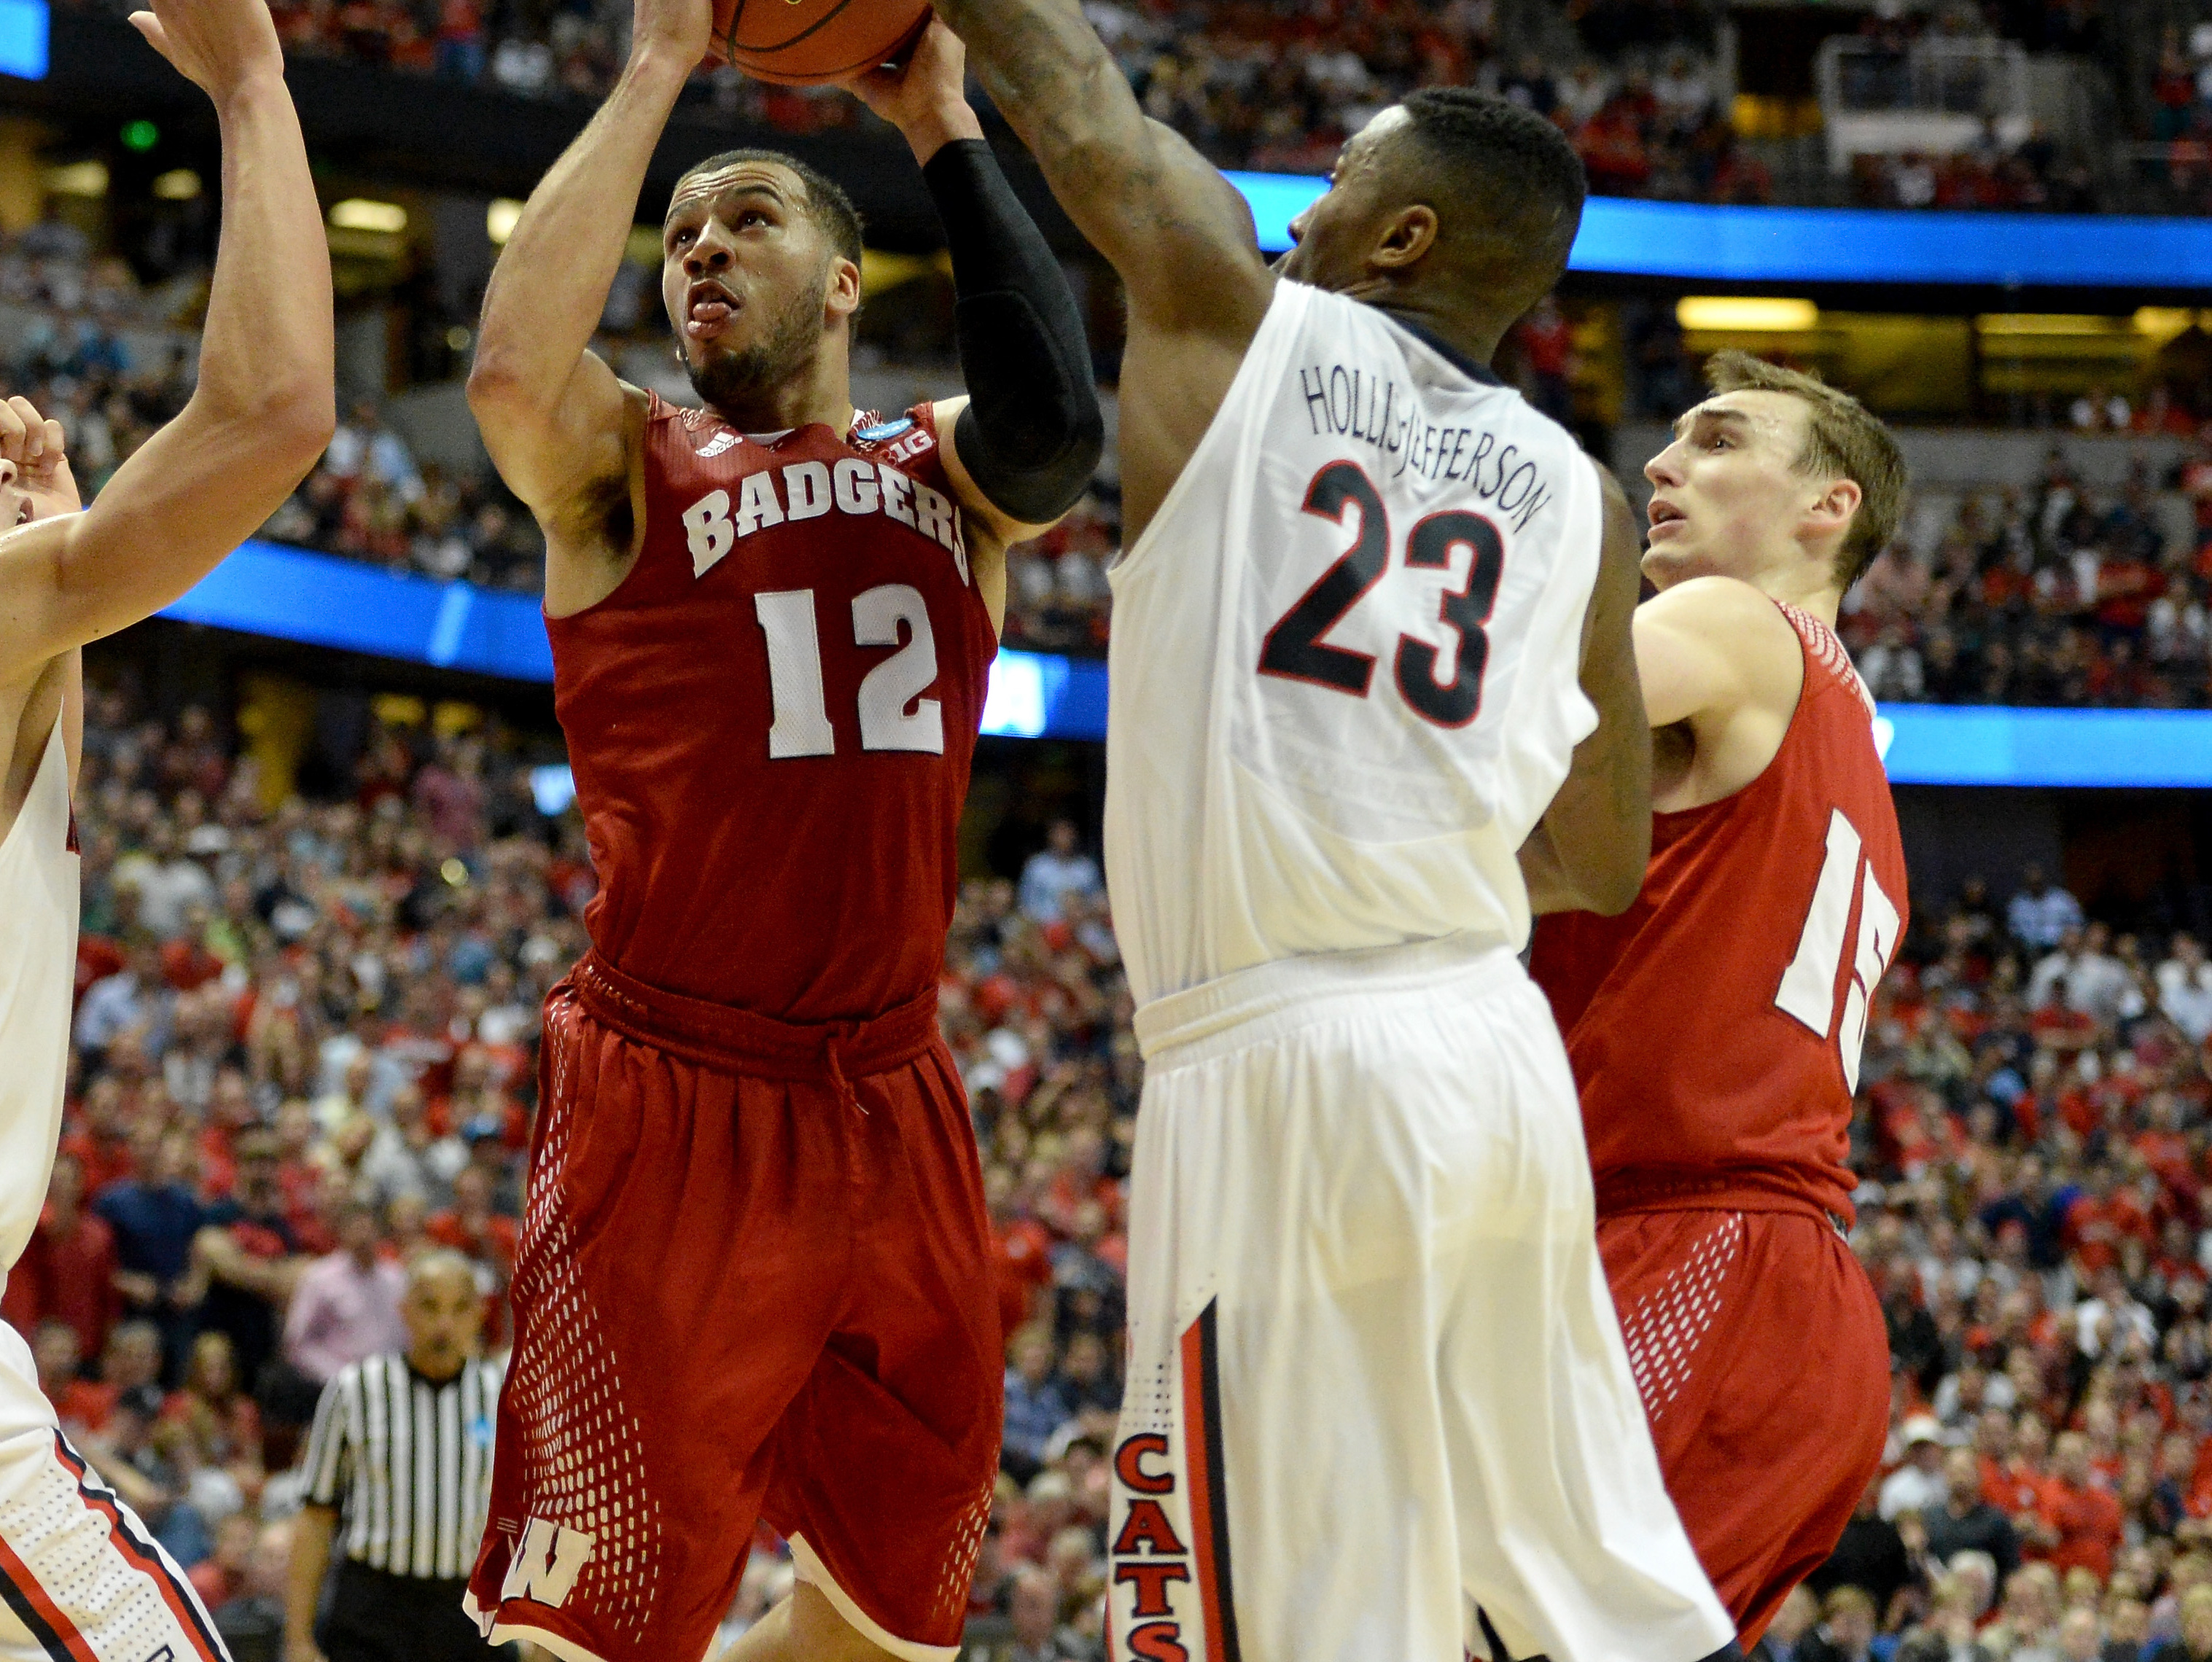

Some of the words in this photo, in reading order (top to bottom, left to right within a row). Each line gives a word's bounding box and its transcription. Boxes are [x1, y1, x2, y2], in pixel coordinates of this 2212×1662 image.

[682, 459, 969, 588] BADGERS
[1256, 459, 1506, 729] 23
[754, 583, 943, 759] 12
[501, 1515, 592, 1609] W
[1111, 1432, 1191, 1662] CATS
